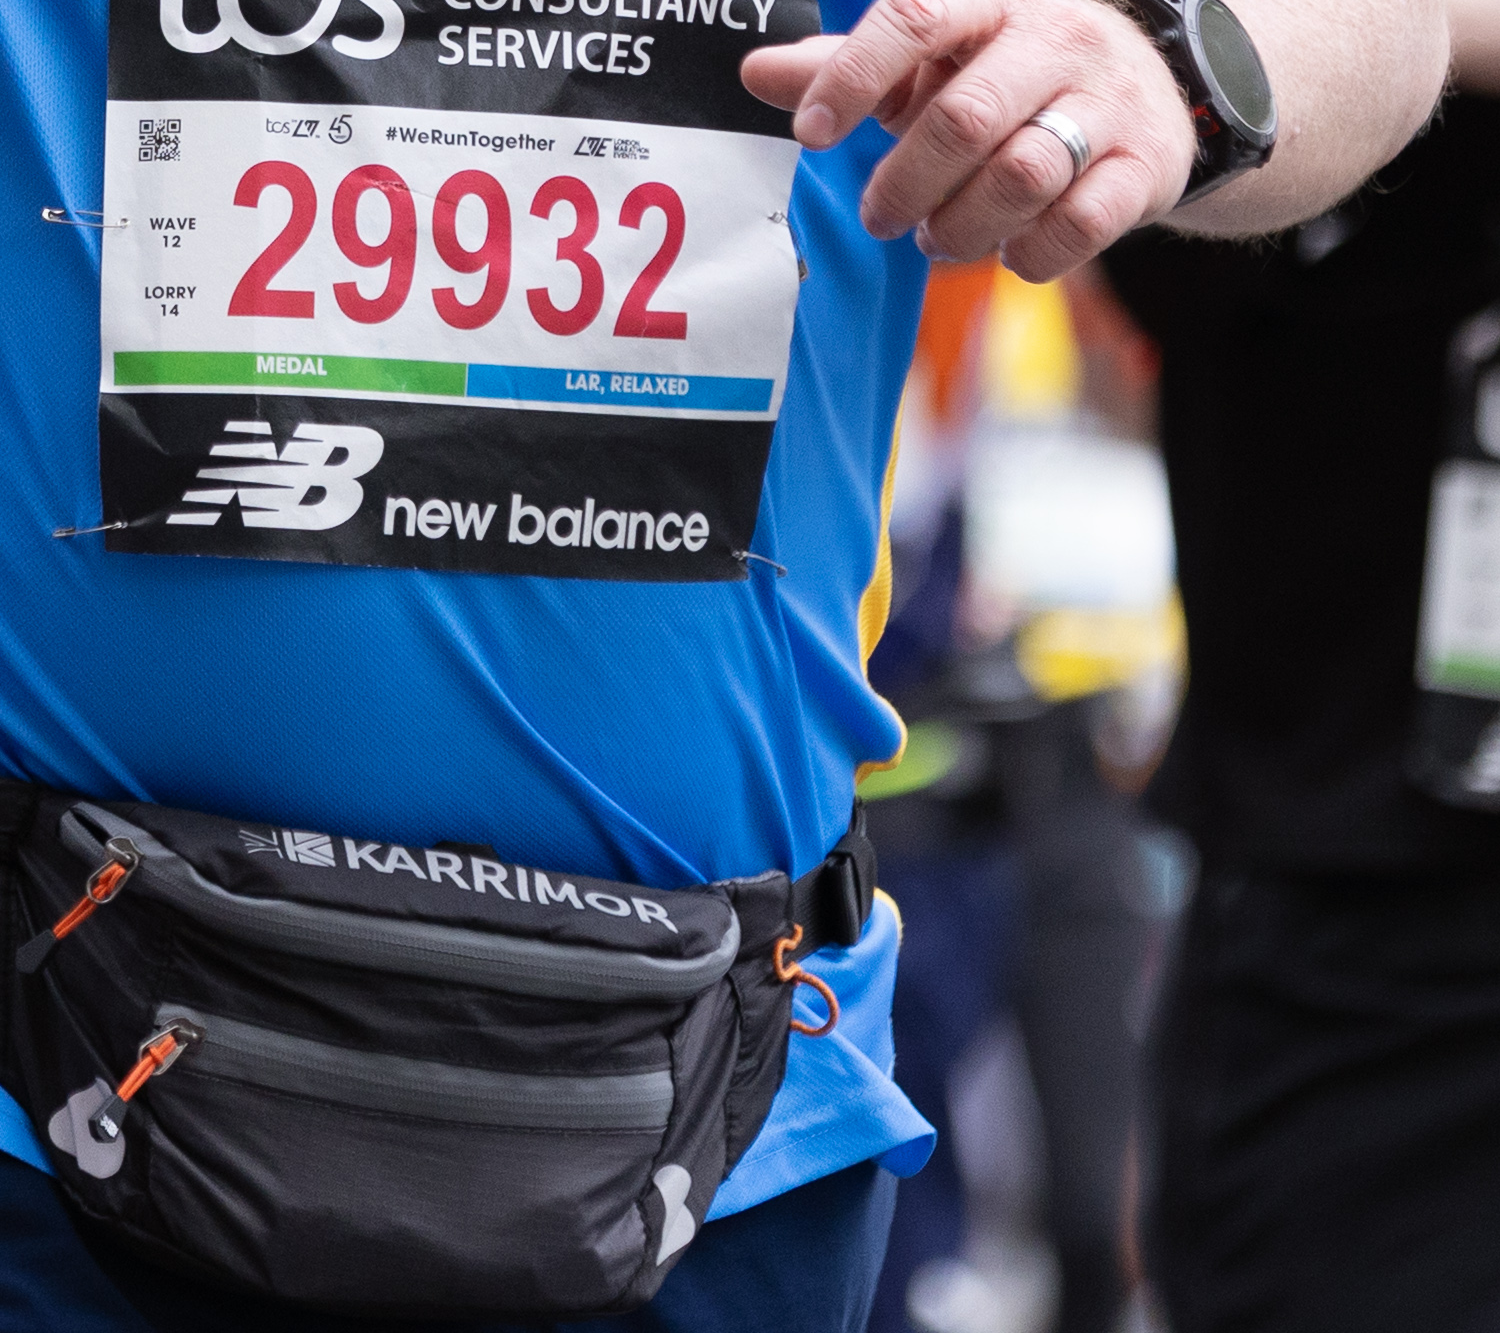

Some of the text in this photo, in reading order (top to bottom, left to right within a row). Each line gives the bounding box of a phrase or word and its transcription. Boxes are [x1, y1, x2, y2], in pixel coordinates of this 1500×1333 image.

[437, 25, 655, 76] SERVICES
[385, 126, 556, 153] #WeRunTogether
[150, 217, 197, 231] WAVE
[162, 235, 182, 248] 12
[226, 160, 688, 341] 29932
[144, 286, 197, 300] LORRY
[160, 304, 180, 317] 14
[255, 355, 328, 376] MEDAL
[565, 372, 690, 396] LAR, RELAXED
[383, 493, 710, 552] new balance
[343, 838, 679, 934] KARRIMOR
